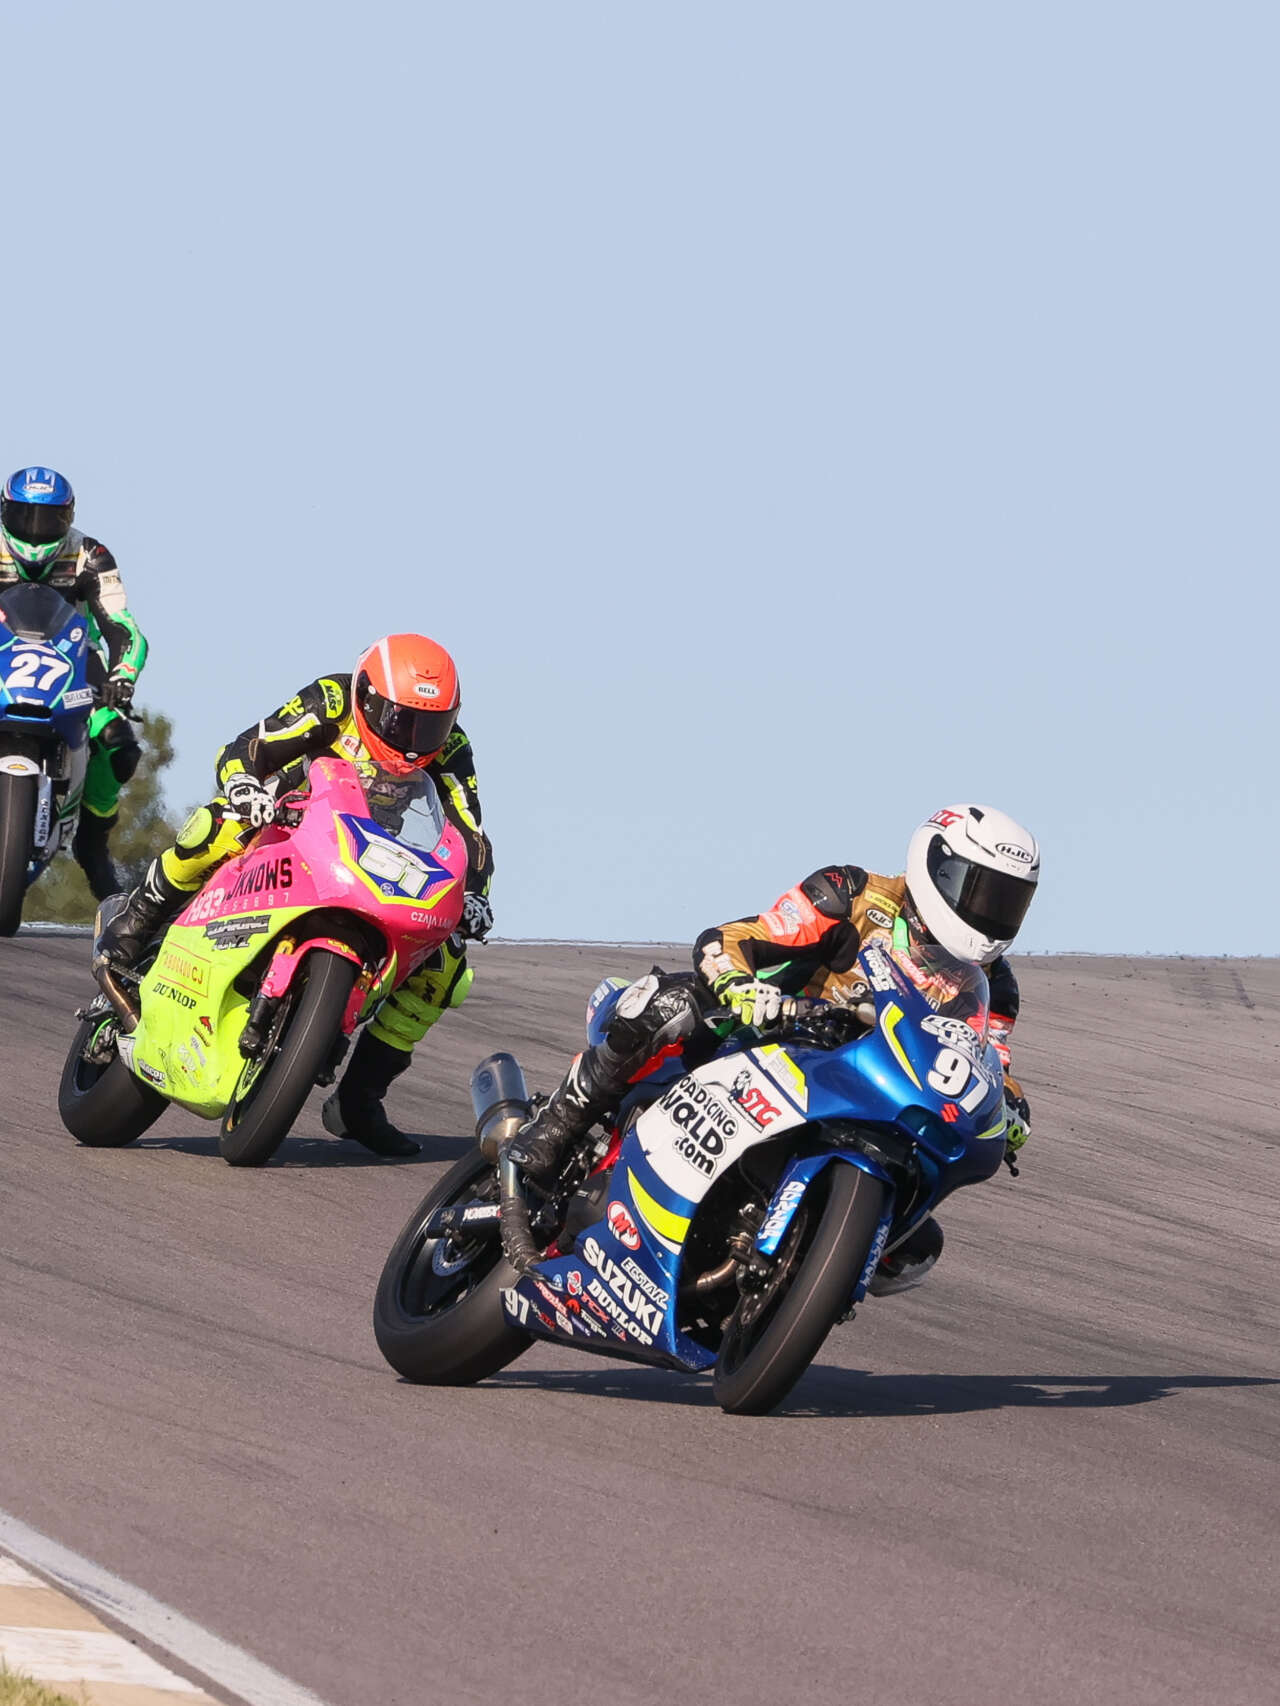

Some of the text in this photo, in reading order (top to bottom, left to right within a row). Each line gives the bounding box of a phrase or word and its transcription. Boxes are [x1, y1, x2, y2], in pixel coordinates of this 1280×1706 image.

[5, 652, 70, 691] 27
[418, 687, 436, 695] BELL
[1000, 844, 1031, 861] HJC
[152, 982, 197, 1010] DUNLOP
[927, 1047, 990, 1114] 97
[738, 1087, 782, 1127] STG
[583, 1237, 664, 1336] SUZUKI
[621, 1257, 669, 1311] ECSTAR
[504, 1288, 529, 1325] 97
[587, 1279, 653, 1347] DUNLOP
